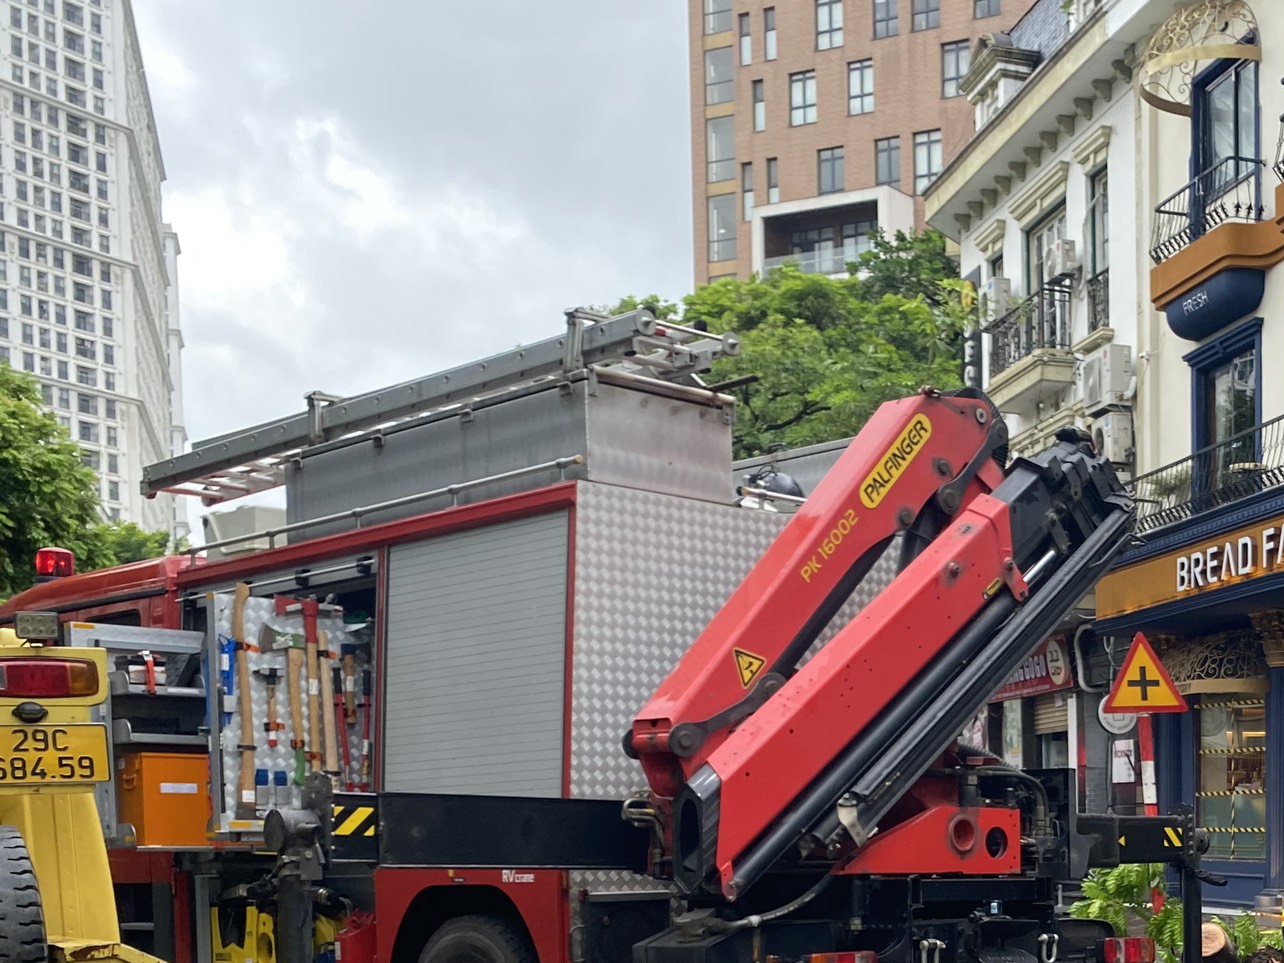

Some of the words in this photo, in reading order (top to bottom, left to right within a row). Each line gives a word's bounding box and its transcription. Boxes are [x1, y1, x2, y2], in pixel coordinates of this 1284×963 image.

[1182, 290, 1209, 316] FRESH
[863, 419, 929, 504] PALFINGER
[800, 556, 822, 583] PK
[817, 508, 859, 560] 16002
[1176, 536, 1252, 592] BREAD
[11, 729, 69, 752] 29C
